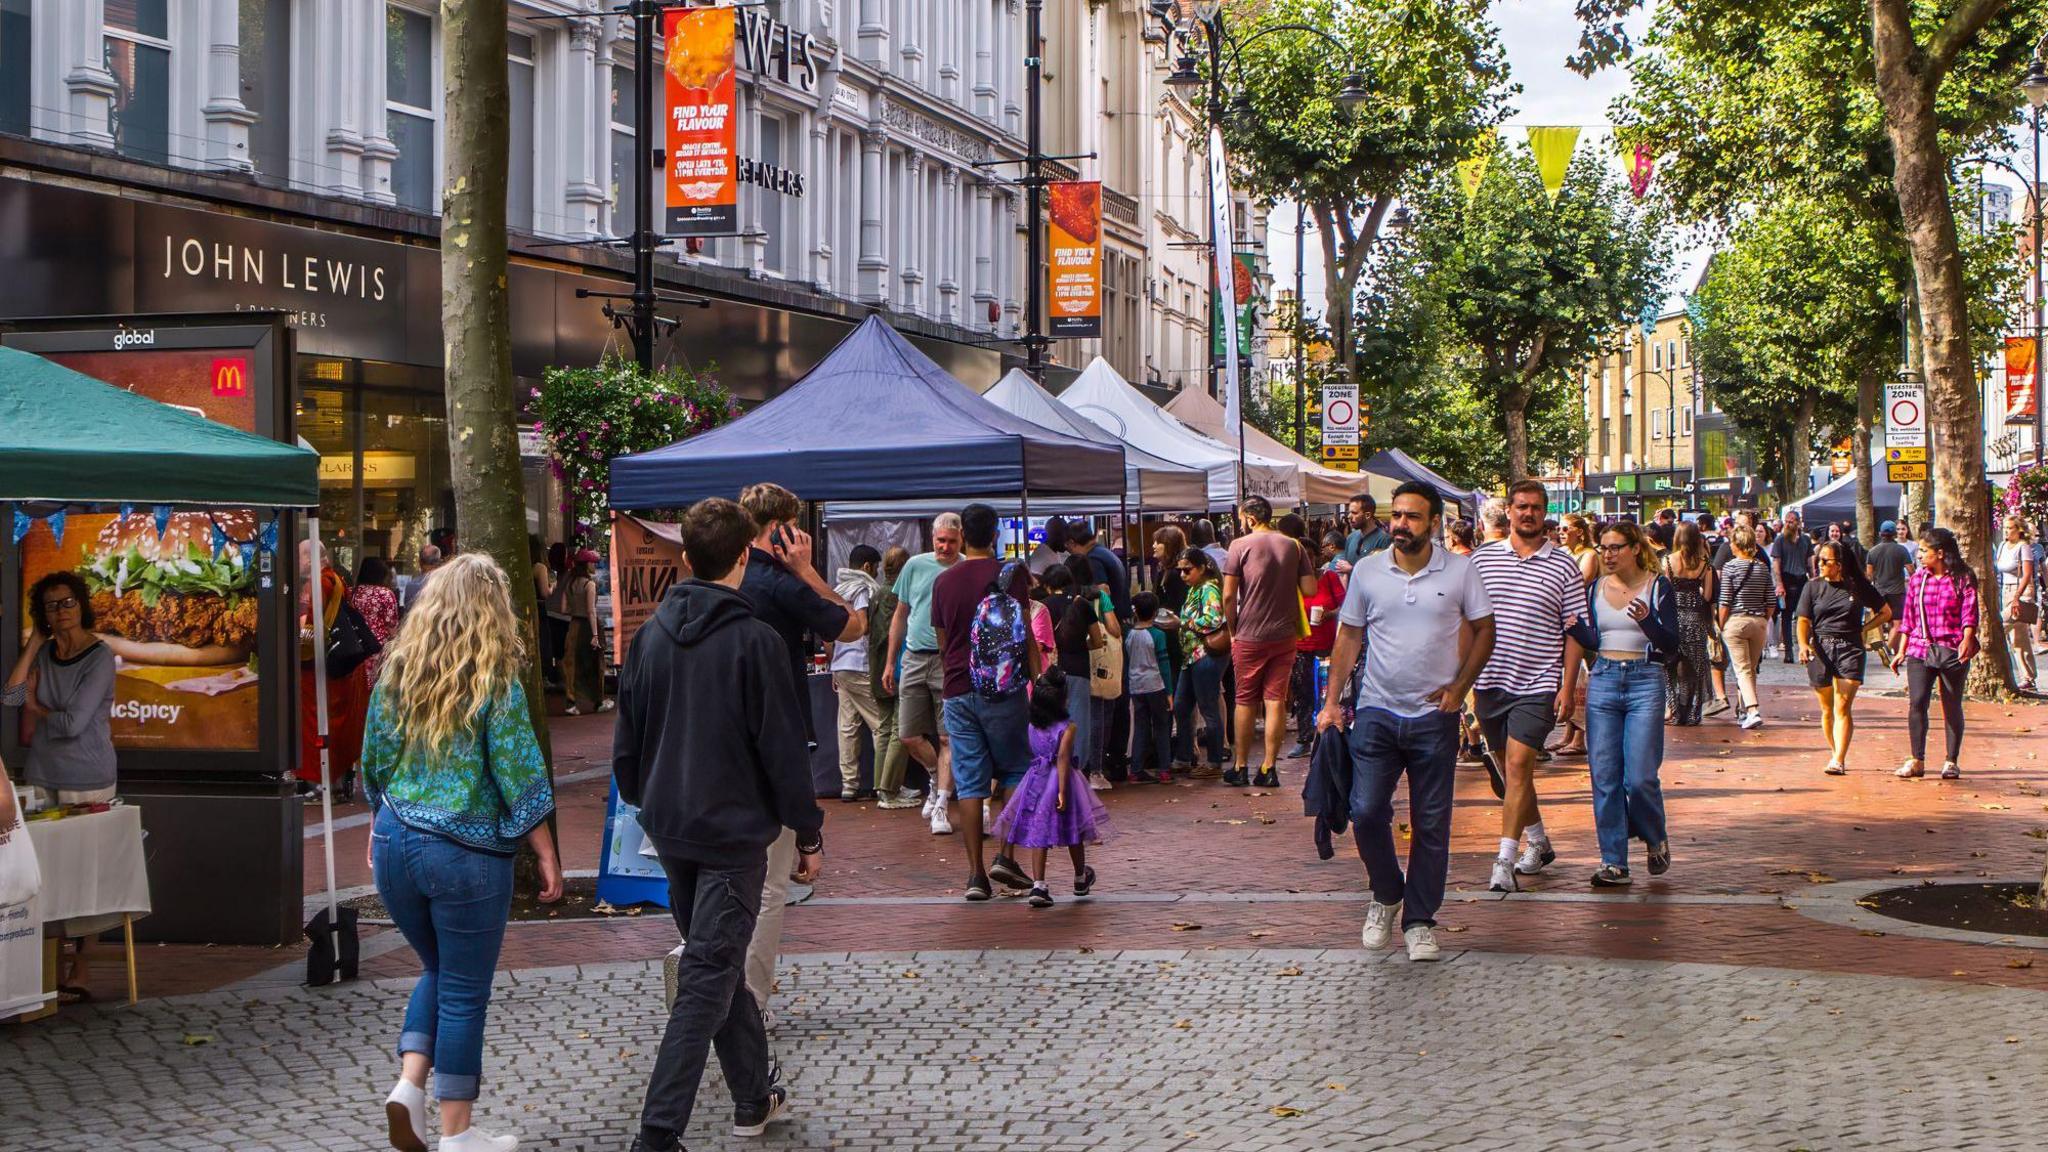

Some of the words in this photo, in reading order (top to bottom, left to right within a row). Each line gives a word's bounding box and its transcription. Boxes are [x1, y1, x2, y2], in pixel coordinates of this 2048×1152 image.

[738, 4, 817, 92] WIS
[673, 105, 697, 120] FIND
[700, 103, 729, 117] YOUR
[677, 117, 724, 131] FLAVOUR
[677, 160, 694, 169] OPEN
[695, 159, 711, 168] LATE
[694, 166, 729, 177] EVERYDAY
[736, 156, 805, 199] RTNERS
[1055, 247, 1073, 257] FIND
[1057, 256, 1092, 266] FLAVOUR
[164, 235, 264, 285] JOHN
[283, 253, 385, 301] LEWIS
[114, 328, 155, 350] global
[1891, 390, 1918, 398] ZONE
[1892, 472, 1924, 480] CYCLING
